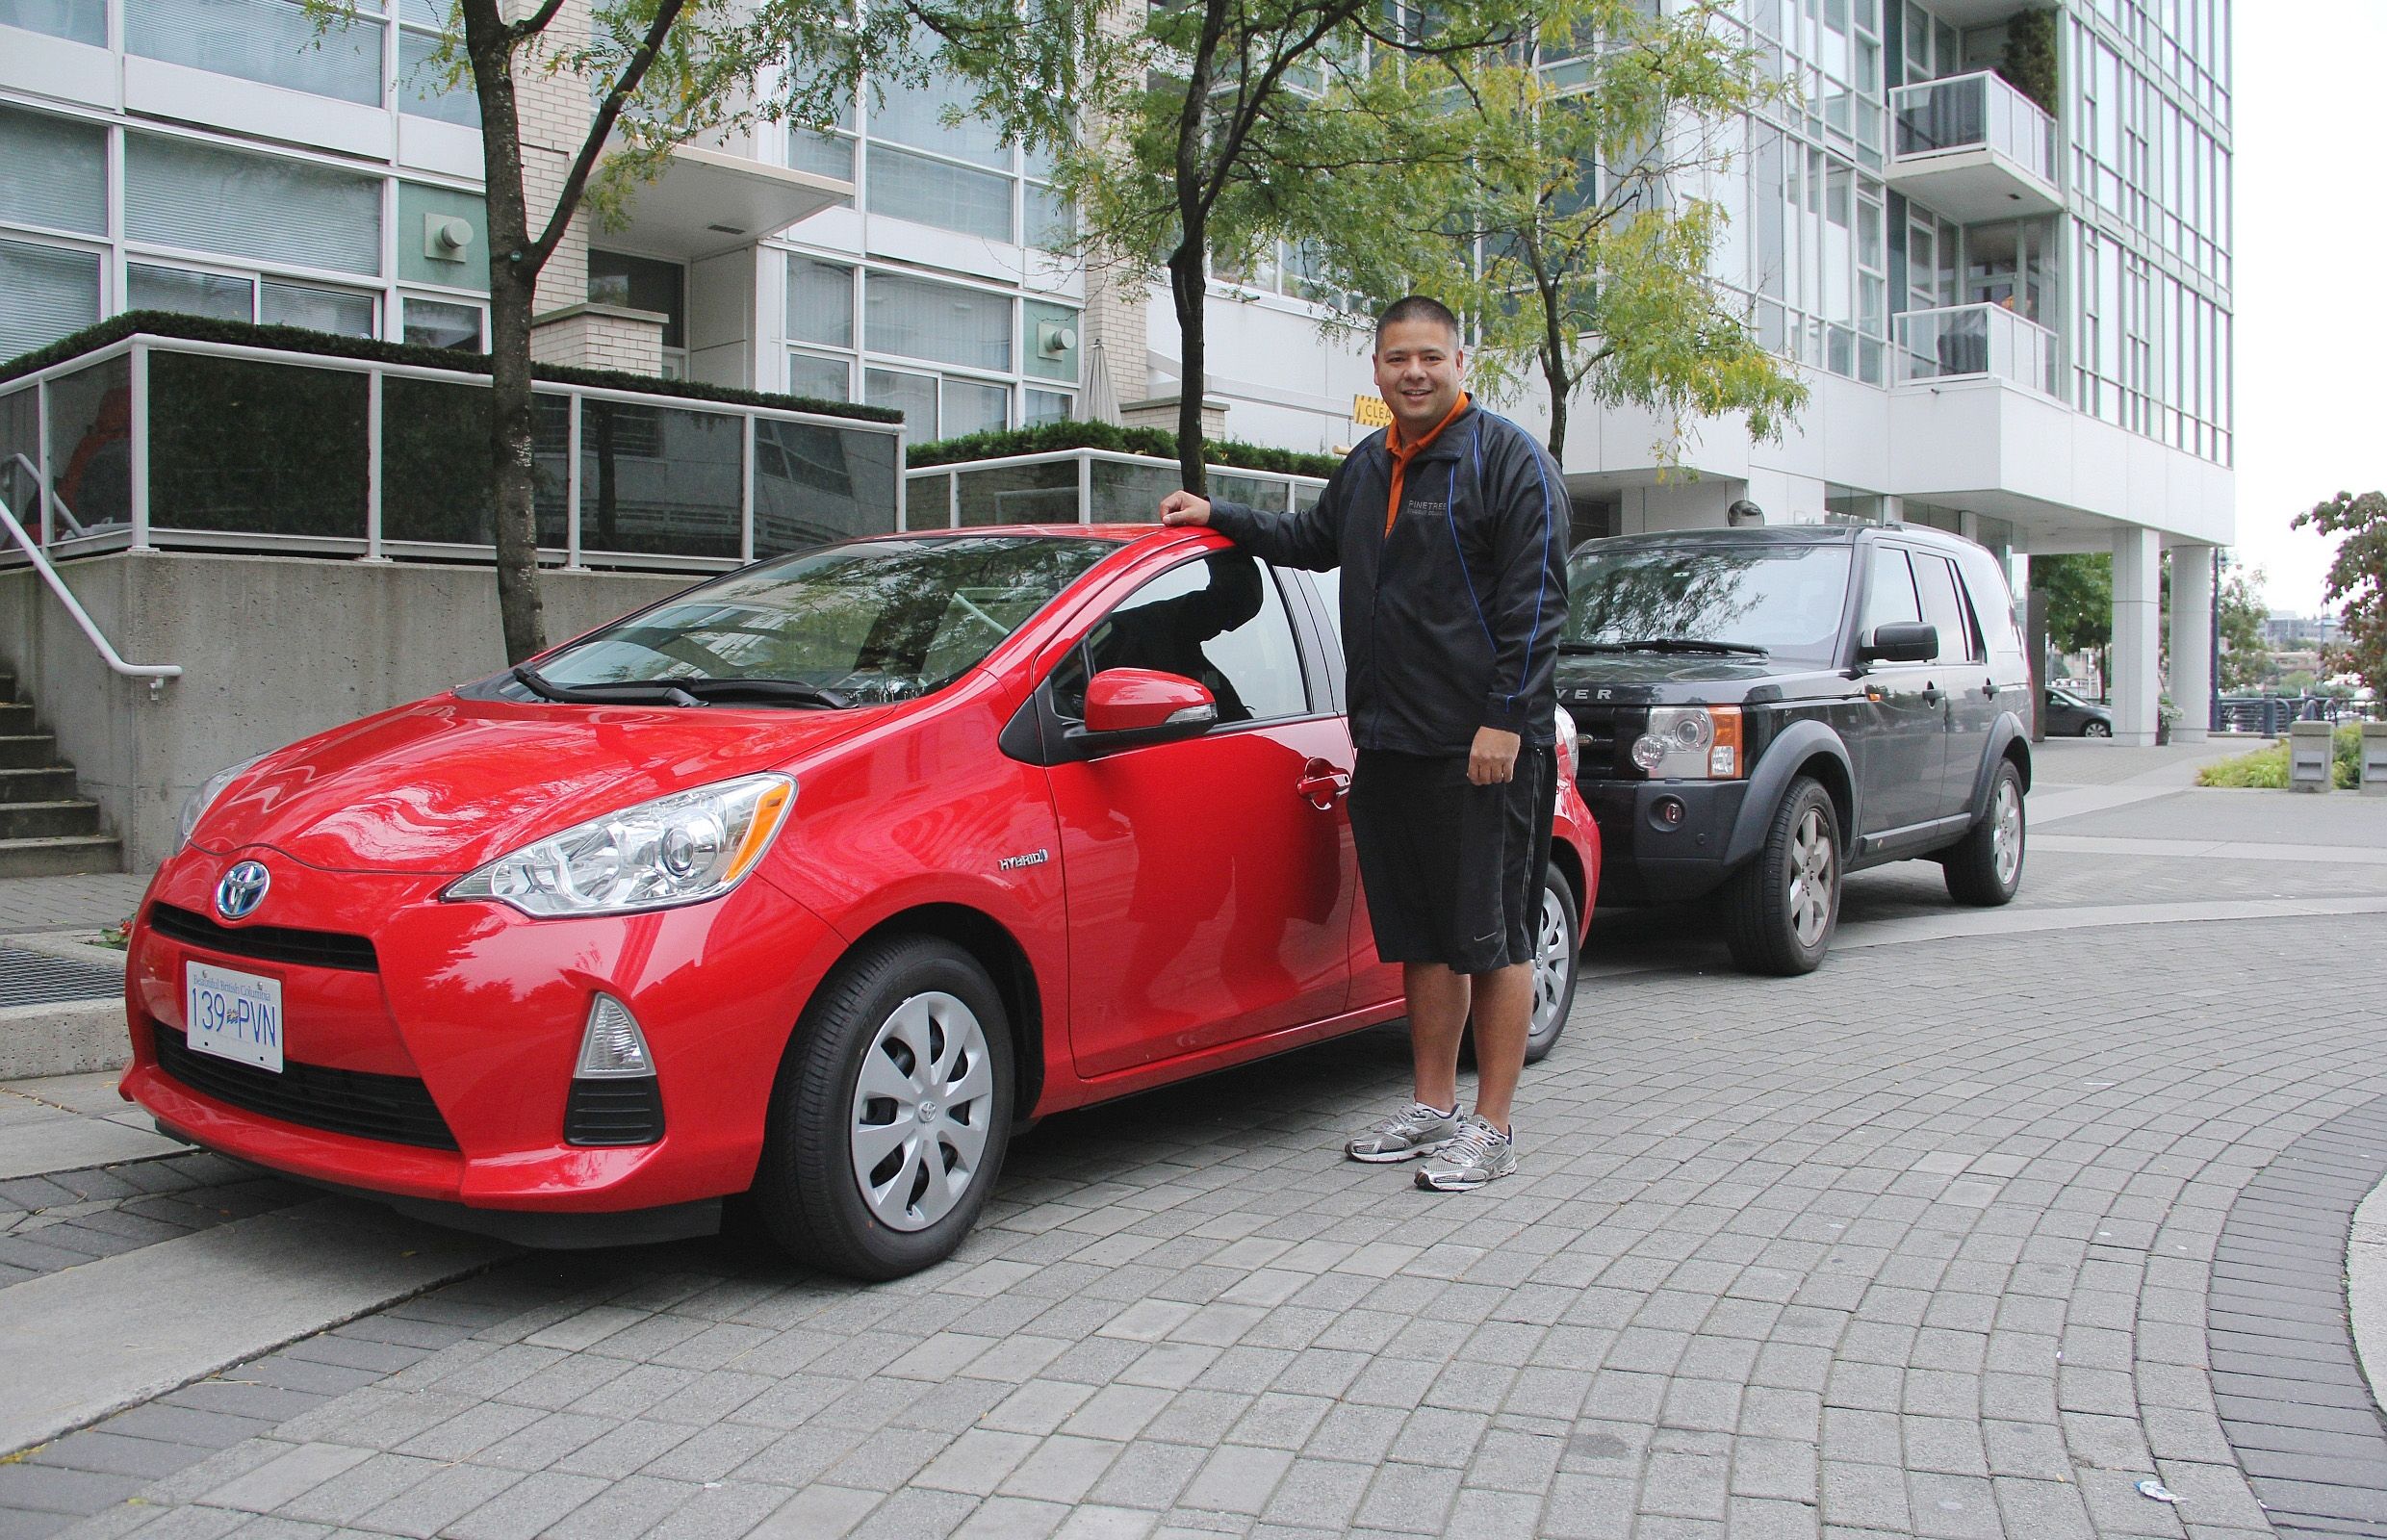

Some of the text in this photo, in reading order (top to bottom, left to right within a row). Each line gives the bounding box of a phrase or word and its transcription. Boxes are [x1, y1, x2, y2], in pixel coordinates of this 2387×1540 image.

[1408, 500, 1448, 511] PINETREE
[998, 853, 1041, 871] HYBRID
[220, 980, 240, 994] British
[241, 985, 271, 1001] Columbia
